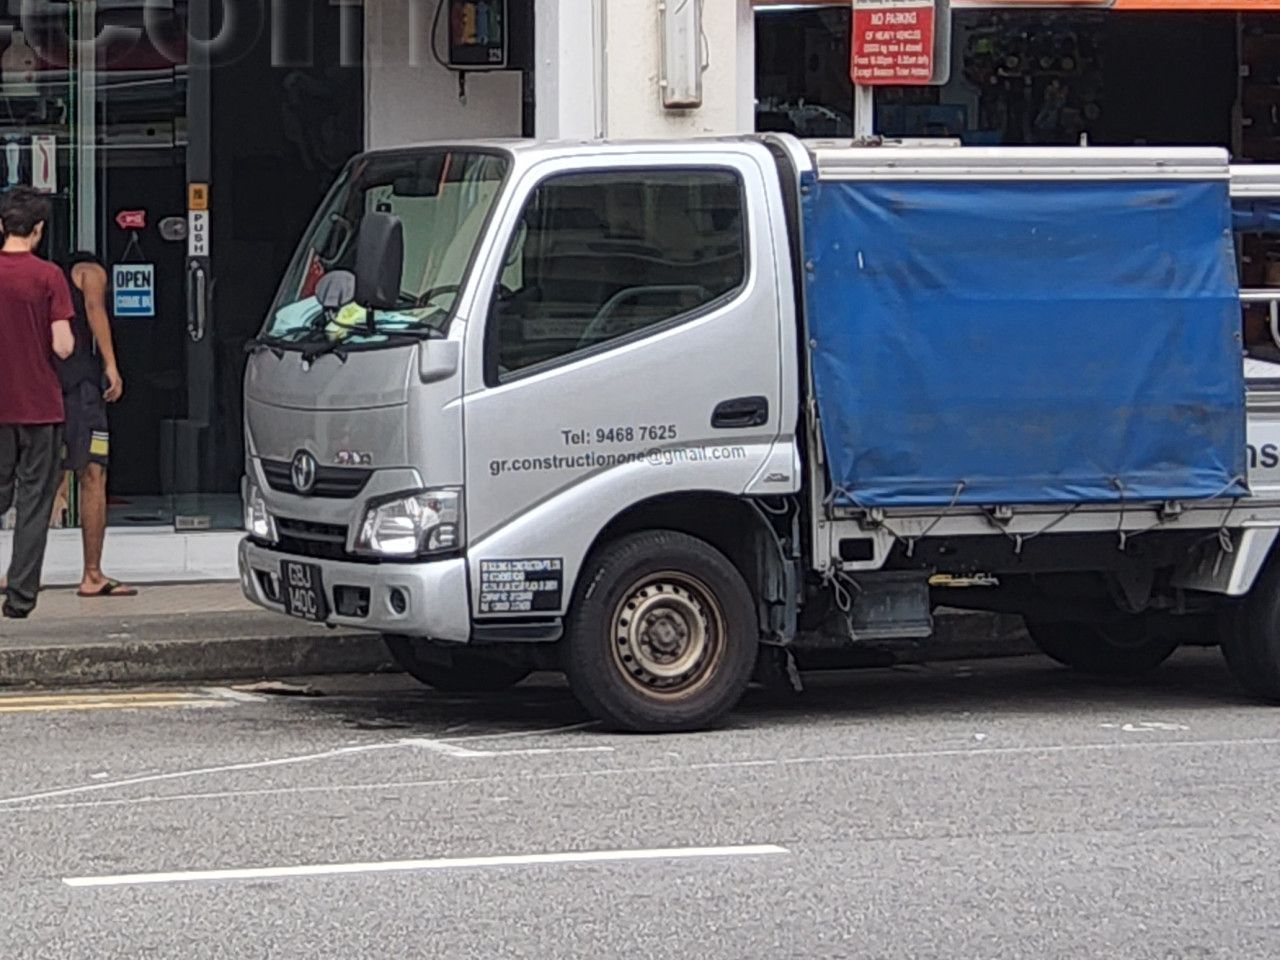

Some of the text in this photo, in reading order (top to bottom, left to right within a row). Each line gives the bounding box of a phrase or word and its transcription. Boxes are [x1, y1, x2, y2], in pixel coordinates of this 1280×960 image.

[116, 270, 151, 288] OPEN
[561, 425, 677, 446] Tel: 9468 7625
